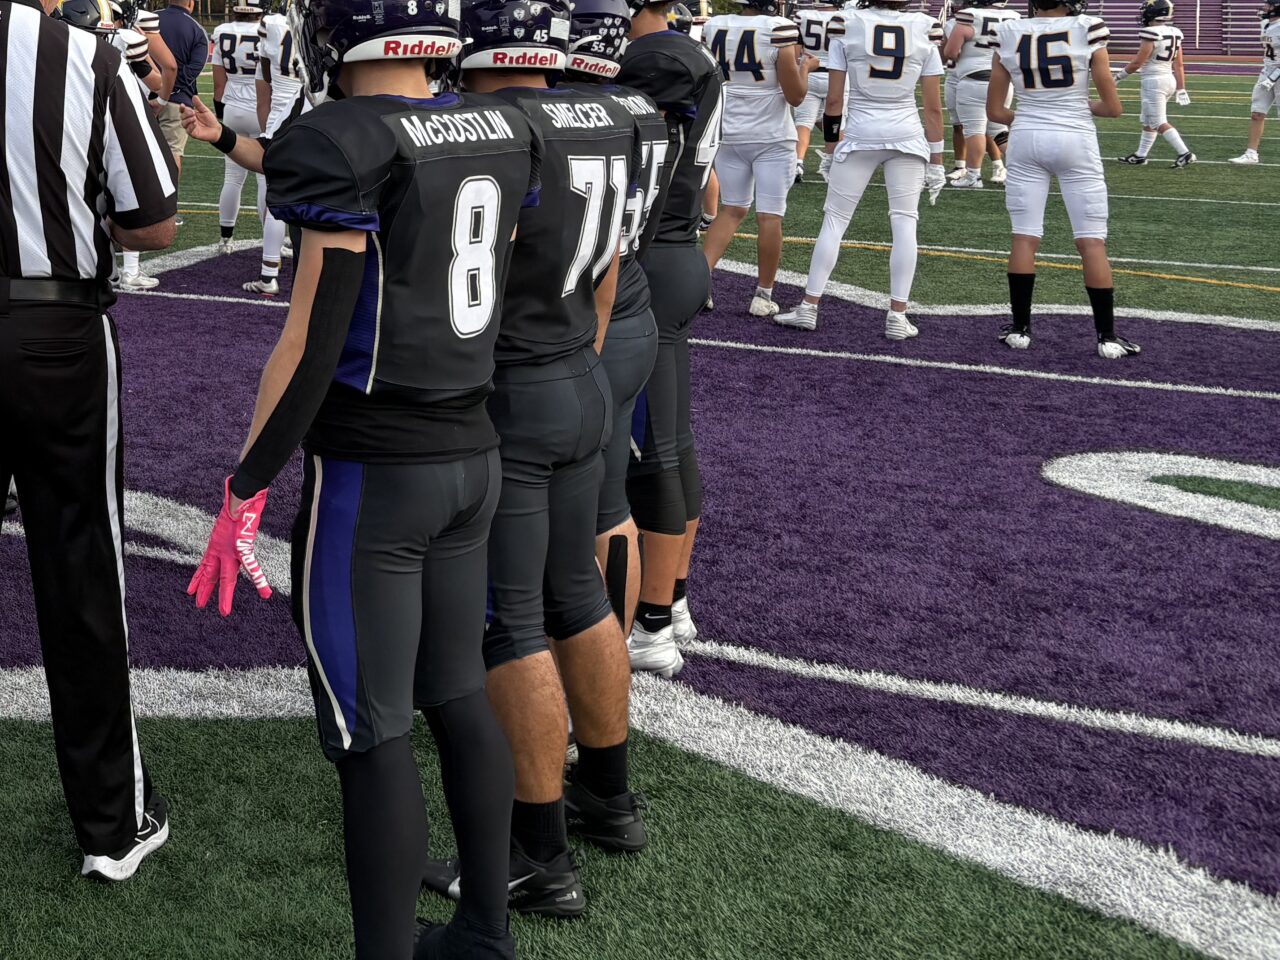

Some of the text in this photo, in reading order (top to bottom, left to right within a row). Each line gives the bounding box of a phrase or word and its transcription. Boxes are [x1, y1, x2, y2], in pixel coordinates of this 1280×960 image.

[407, 0, 418, 15] 8
[533, 29, 548, 42] 45
[590, 40, 605, 53] 55
[869, 24, 906, 80] 9
[220, 32, 261, 75] 83
[493, 51, 558, 66] Riddell
[571, 56, 618, 75] Riddell
[711, 29, 765, 81] 44
[1016, 31, 1075, 90] 16
[401, 109, 515, 148] McCOSTLIN
[541, 102, 615, 129] SMELCER
[448, 174, 502, 339] 8
